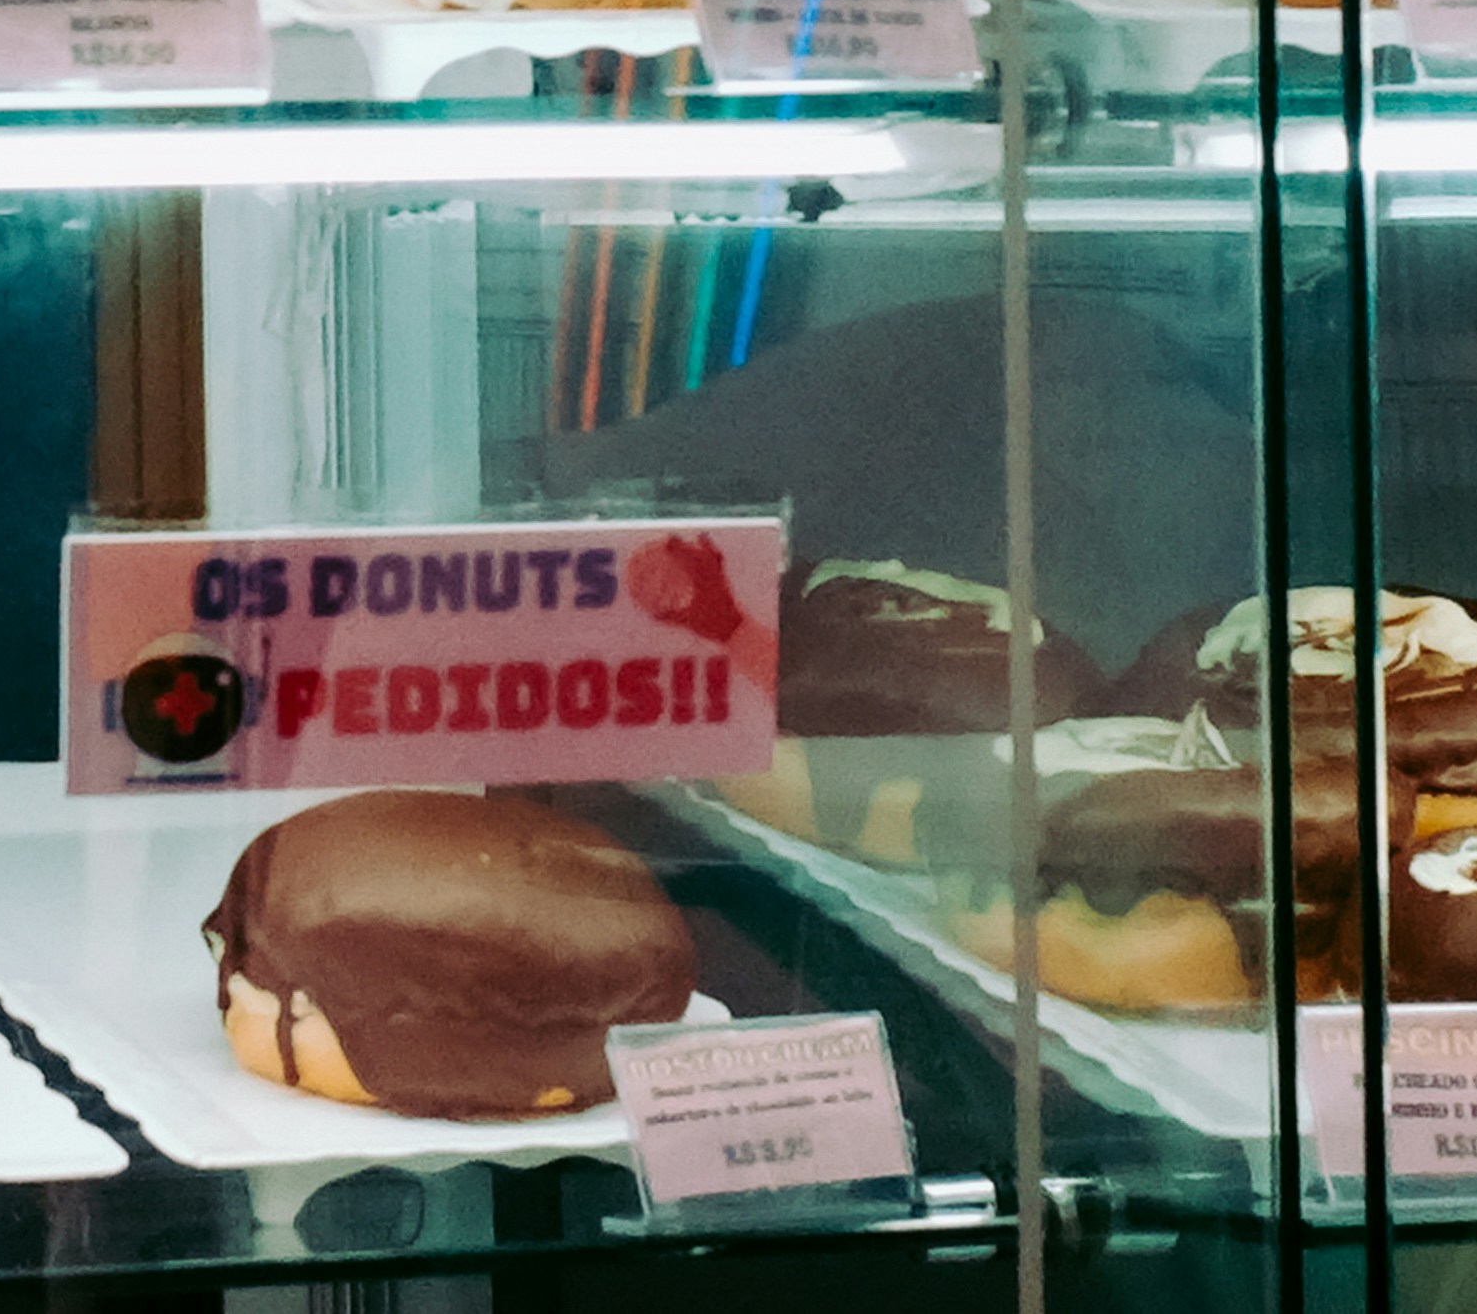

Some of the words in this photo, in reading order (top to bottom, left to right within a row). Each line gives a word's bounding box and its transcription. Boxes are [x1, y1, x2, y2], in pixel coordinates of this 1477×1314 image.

[192, 556, 291, 622] OS
[309, 547, 619, 618] DONUTS
[275, 655, 731, 739] PEDIDOS!!
